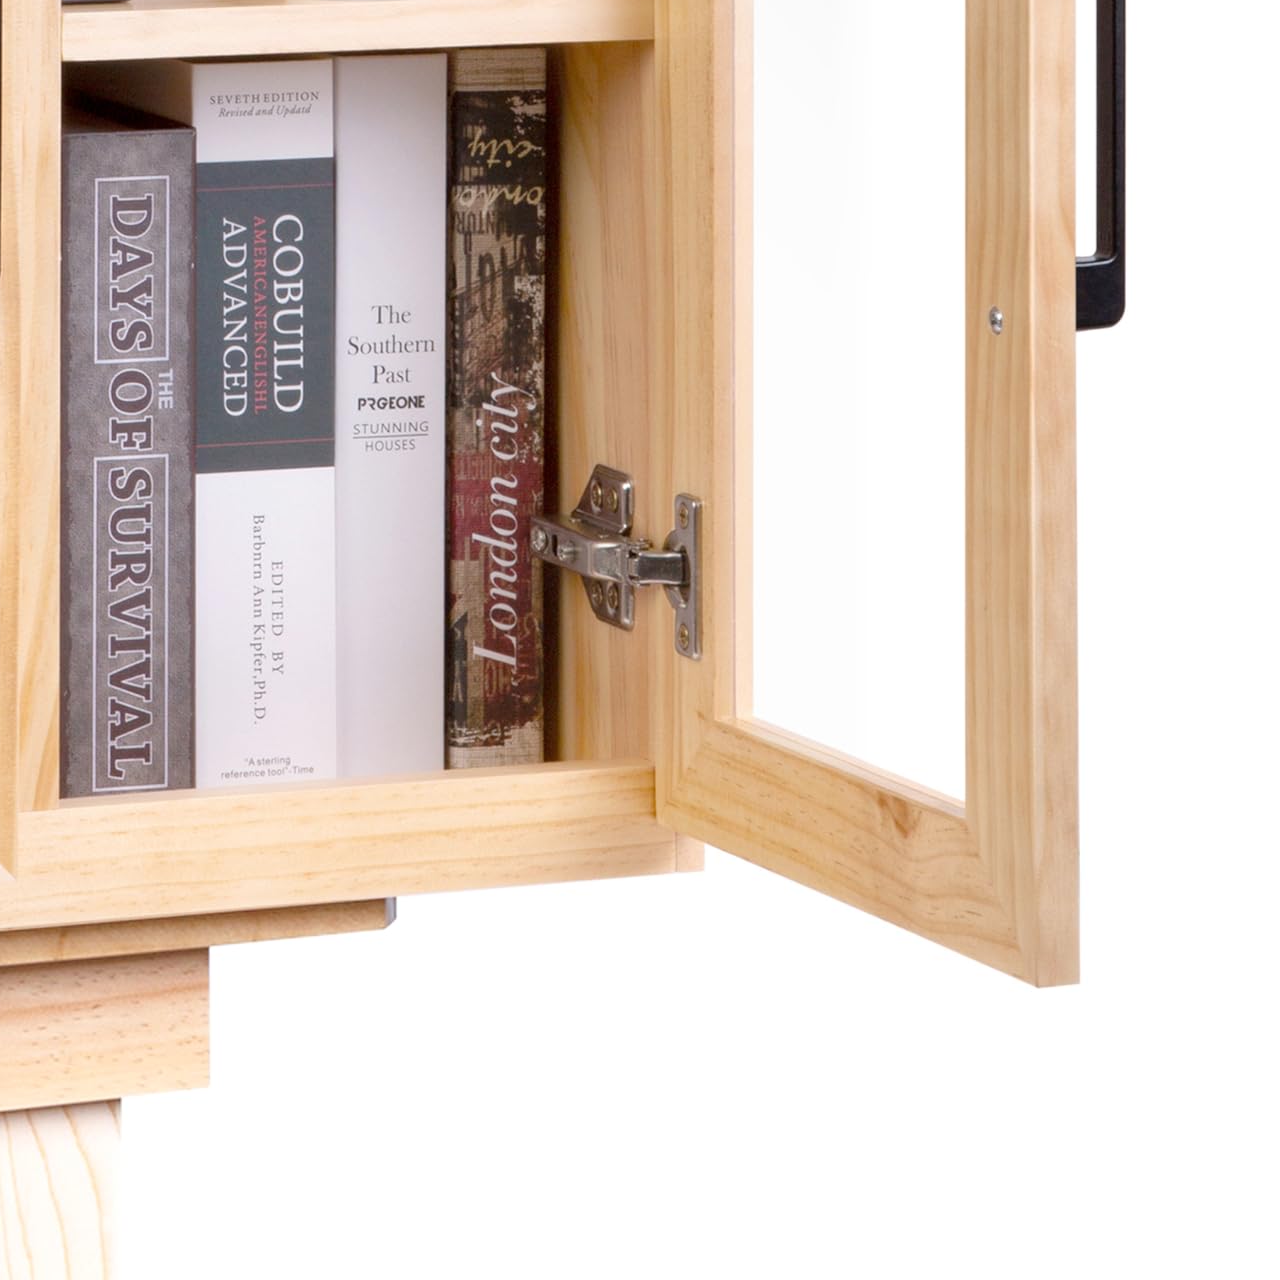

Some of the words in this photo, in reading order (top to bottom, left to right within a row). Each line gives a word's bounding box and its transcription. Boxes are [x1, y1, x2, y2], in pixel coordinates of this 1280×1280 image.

[209, 93, 260, 105] SEVETH
[263, 91, 320, 103] EDITION
[218, 106, 254, 118] Revised
[255, 105, 274, 116] and
[109, 193, 154, 353] DAYS
[223, 217, 248, 417] ADVANCED
[272, 214, 304, 413] COBUILD
[371, 304, 411, 324] The
[347, 334, 435, 356] Southern
[158, 368, 174, 409] THE
[372, 364, 412, 385] Past
[108, 368, 154, 451] OF
[476, 371, 536, 461] city
[353, 421, 429, 436] STUNNING
[365, 439, 416, 452] HOUSES
[471, 473, 519, 669] London
[253, 585, 265, 618] Ann
[271, 561, 285, 637] EDITED
[107, 466, 153, 781] SURVIVAL
[271, 651, 285, 675] BY
[221, 770, 265, 780] reference
[257, 757, 291, 766] sterling
